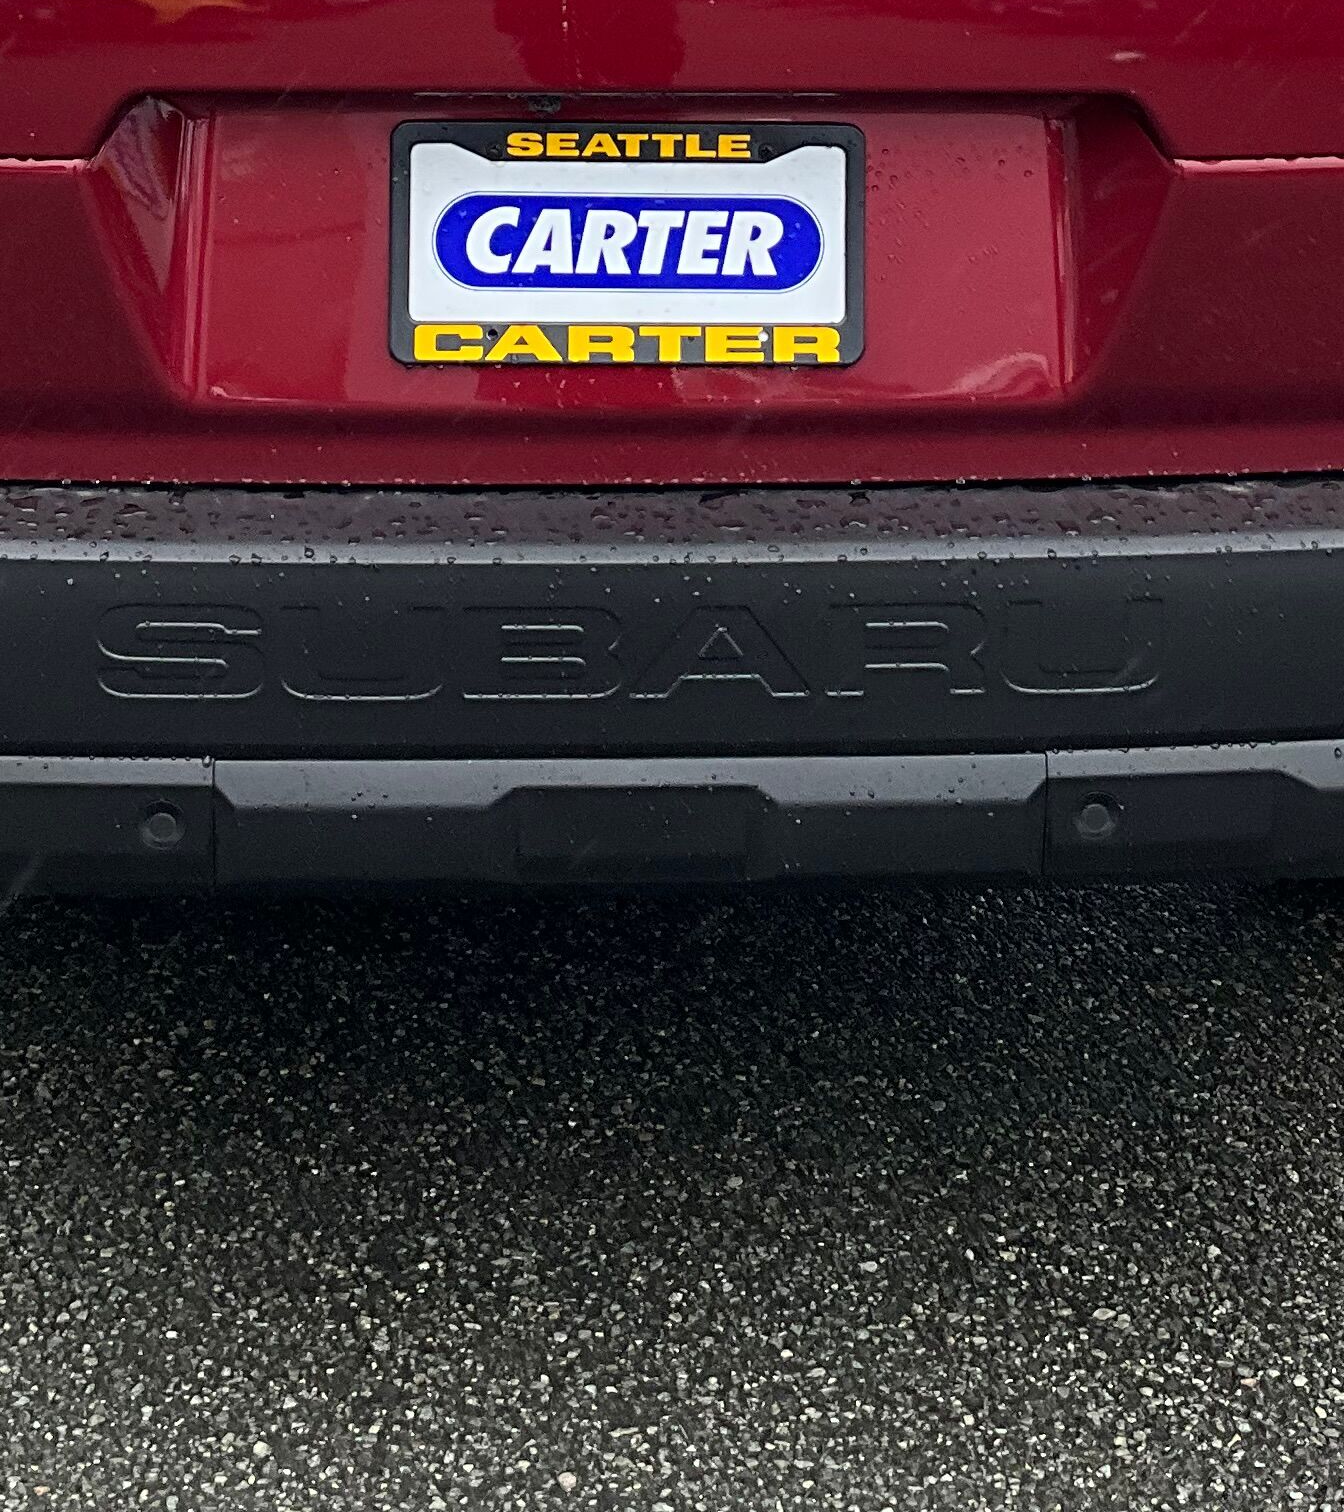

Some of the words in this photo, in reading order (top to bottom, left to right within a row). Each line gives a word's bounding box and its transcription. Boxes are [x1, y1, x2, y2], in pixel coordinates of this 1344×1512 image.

[507, 132, 751, 159] SEATTLE
[465, 206, 784, 276] CARTER
[413, 325, 840, 363] CARTER
[96, 597, 1163, 702] SUBARU
